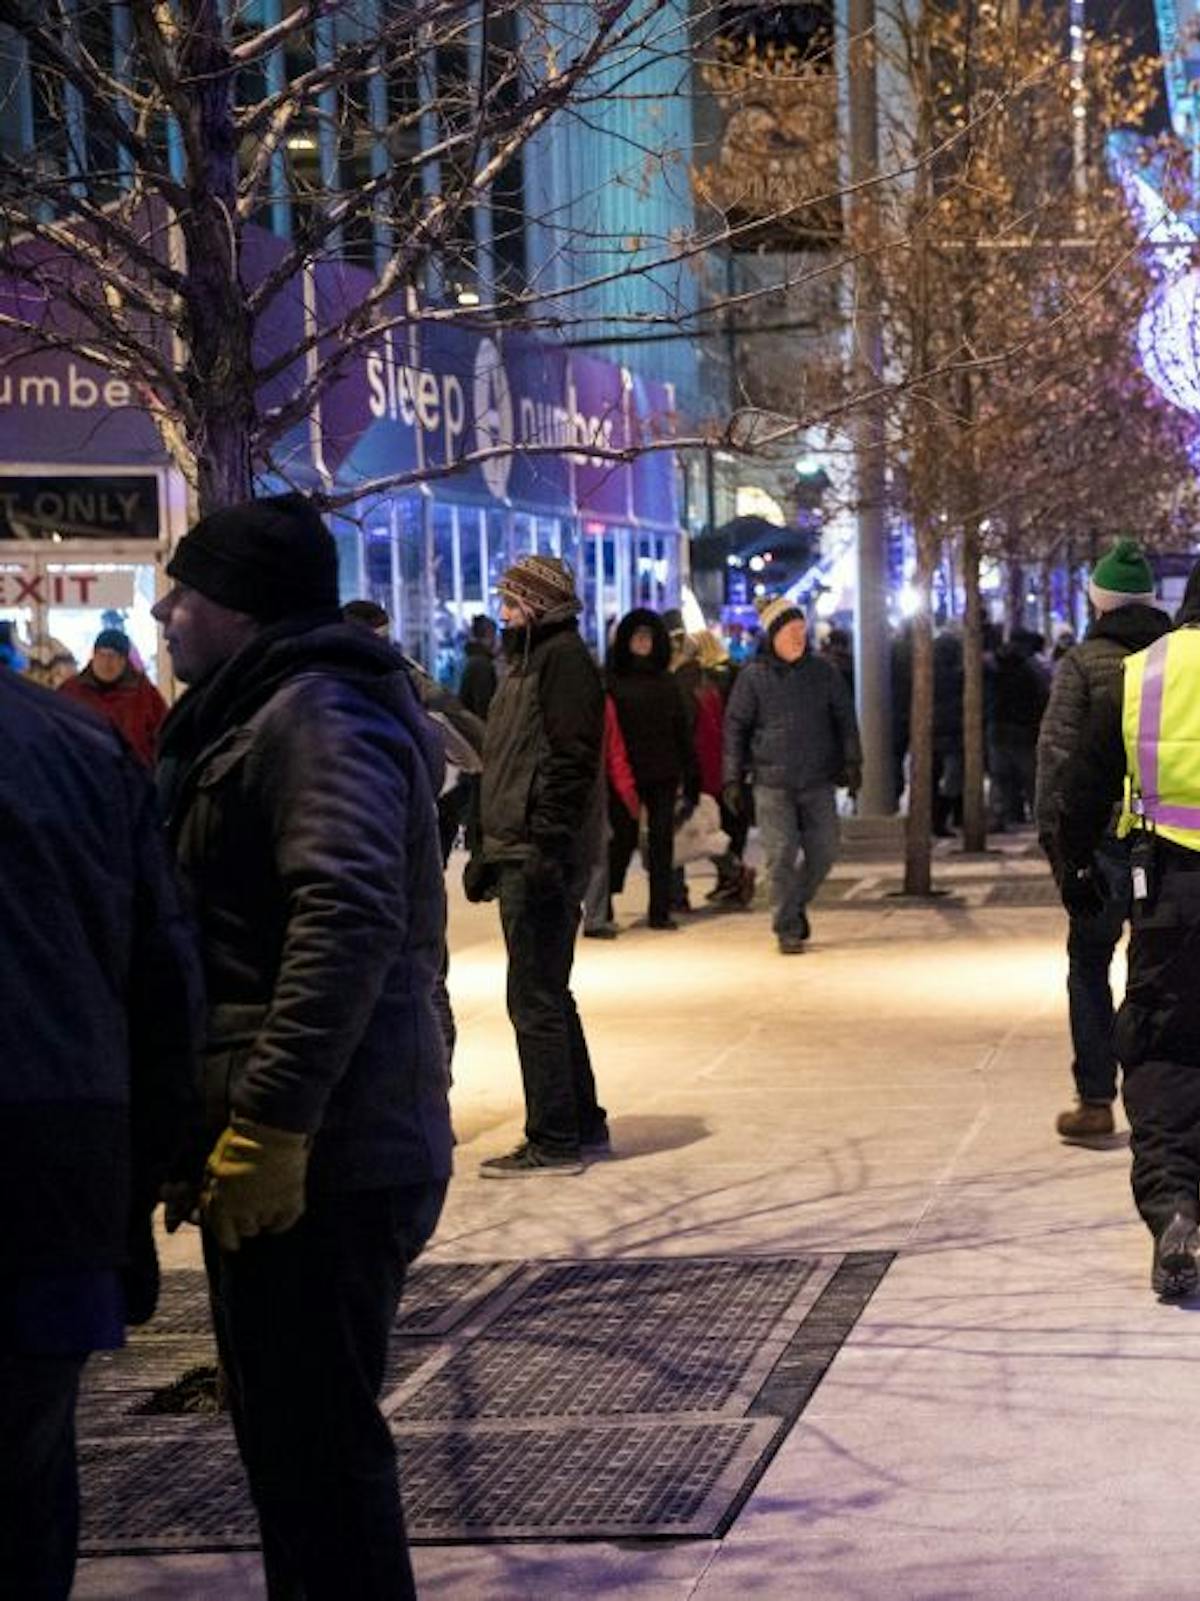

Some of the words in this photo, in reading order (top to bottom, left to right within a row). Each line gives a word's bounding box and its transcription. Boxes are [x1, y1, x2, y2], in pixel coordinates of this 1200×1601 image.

[367, 351, 464, 466] sleep
[33, 491, 140, 523] ONLY
[0, 575, 97, 604] XIT
